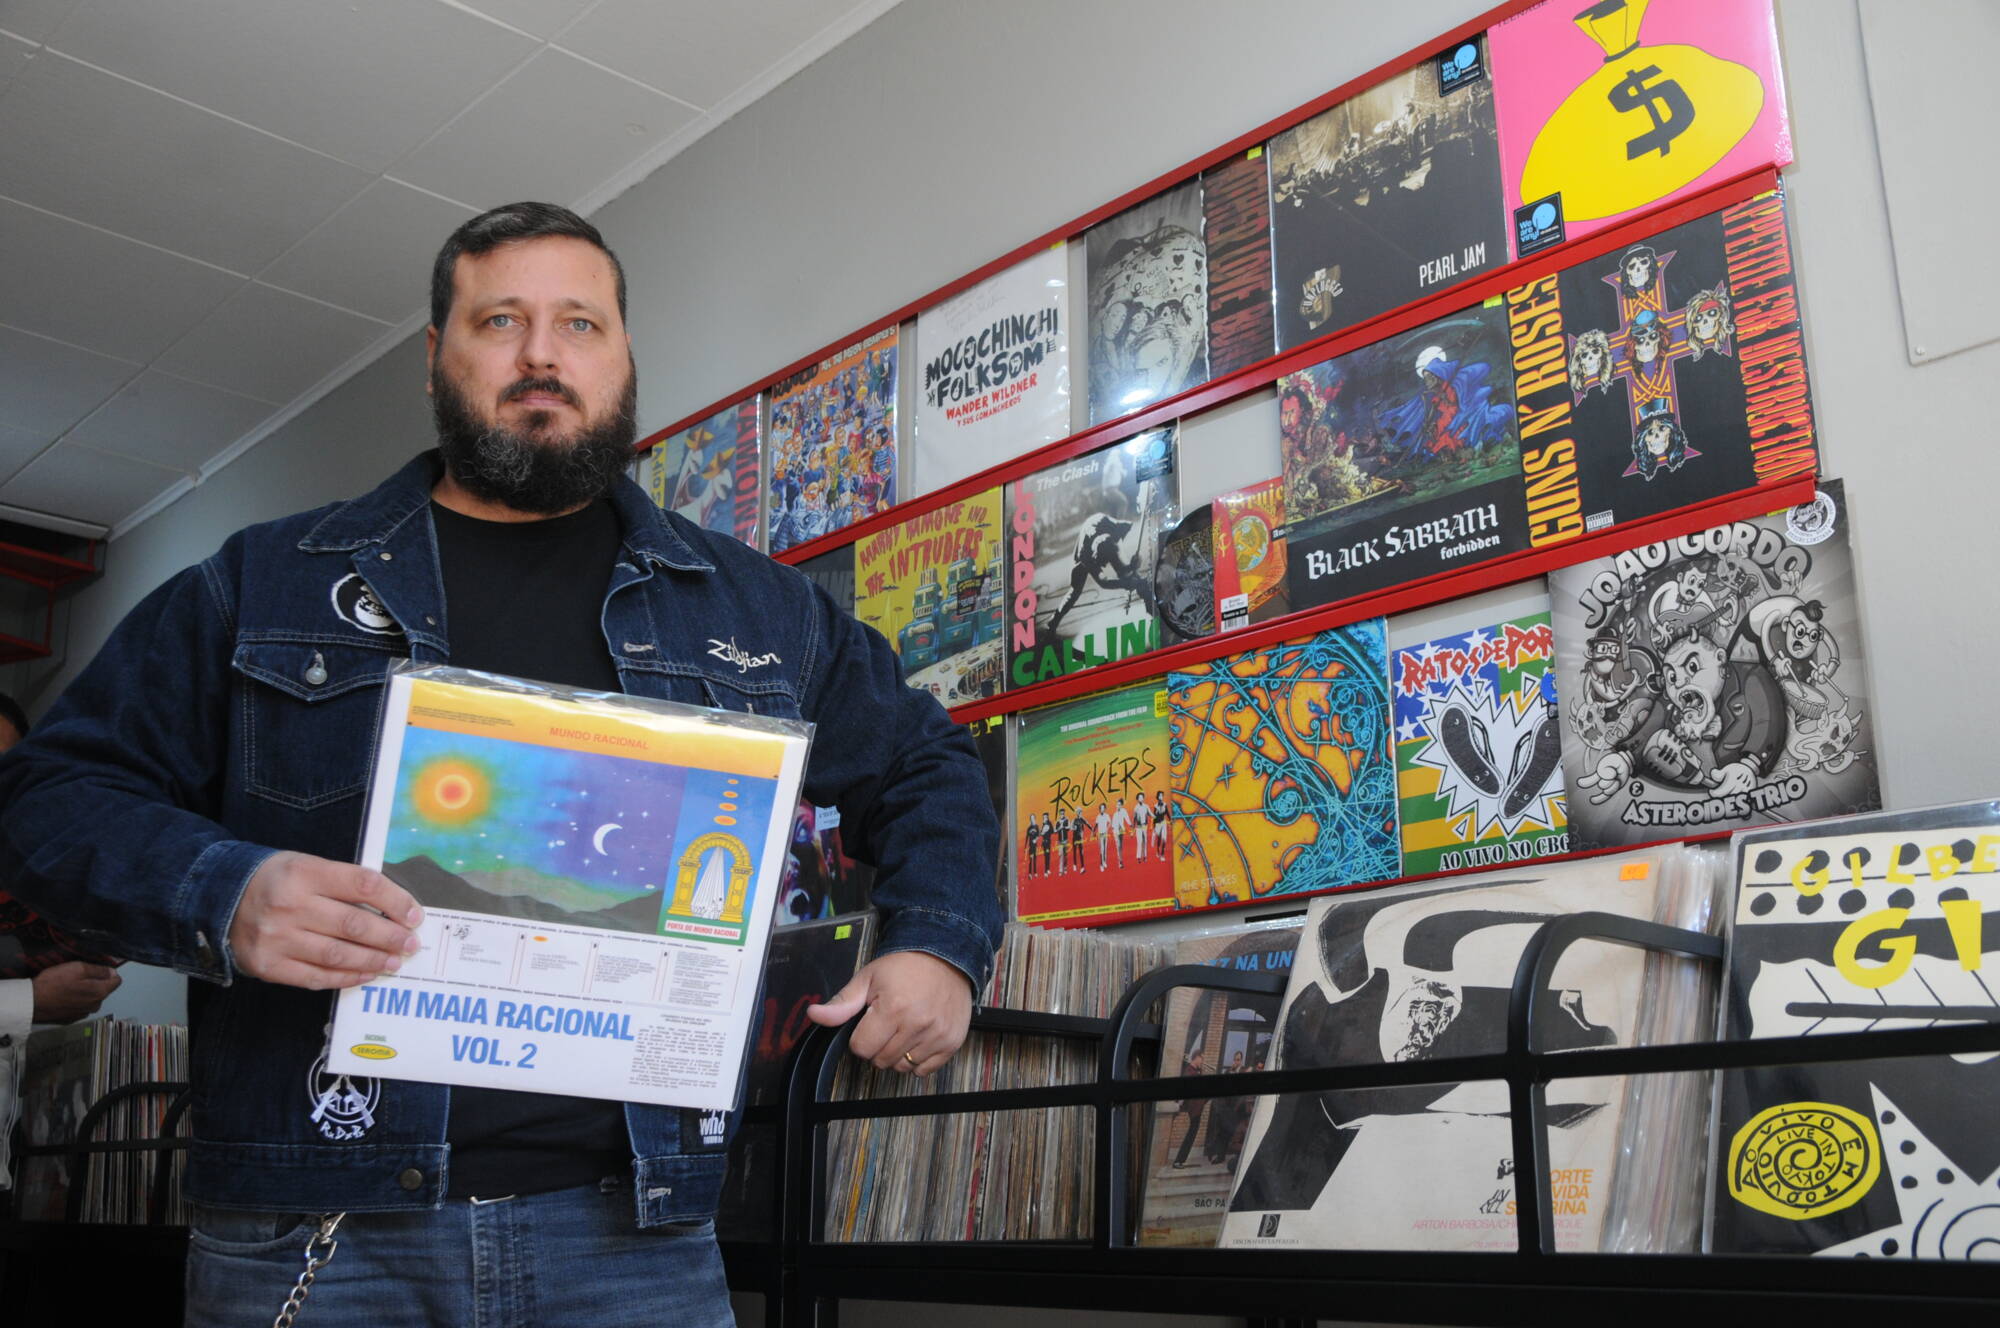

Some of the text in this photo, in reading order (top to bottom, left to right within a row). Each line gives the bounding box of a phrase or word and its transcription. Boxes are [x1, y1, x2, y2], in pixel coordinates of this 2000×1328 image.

[1418, 241, 1486, 288] PEARL JAM
[1303, 279, 1344, 307] UNPLUGGED
[1733, 283, 1798, 343] FOR
[925, 307, 1059, 391] MOCOCHINCHI
[1507, 272, 1568, 400] ROSES
[946, 373, 1038, 420] WANDER WILDNER
[957, 395, 1022, 428] Y SUS COMANCHEROS
[1036, 459, 1099, 492] The Clash
[1522, 437, 1584, 548] GUNS
[889, 527, 984, 584] INTRUDERS
[1012, 478, 1037, 653] LONDON
[1305, 504, 1499, 580] BLACK SABBATH
[1440, 534, 1501, 560] forbidden
[1676, 521, 1813, 588] GORDO
[707, 636, 782, 674] Zildjian
[549, 727, 649, 750] MUNDO RACIONAL
[1621, 775, 1808, 827] ASTEROIDES TRIO
[1439, 853, 1461, 872] AO
[1463, 846, 1504, 869] VIVO
[1507, 842, 1532, 862] NO
[667, 922, 739, 938] PORTA DO MUNDO RACIONAL
[1235, 954, 1259, 971] NA
[360, 985, 410, 1017] TIM
[415, 991, 488, 1025] MAIA
[495, 1000, 636, 1042] RACIONAL
[451, 1034, 538, 1069] VOL. 2
[1776, 1128, 1816, 1145] LIVE
[1819, 1138, 1837, 1157] IN
